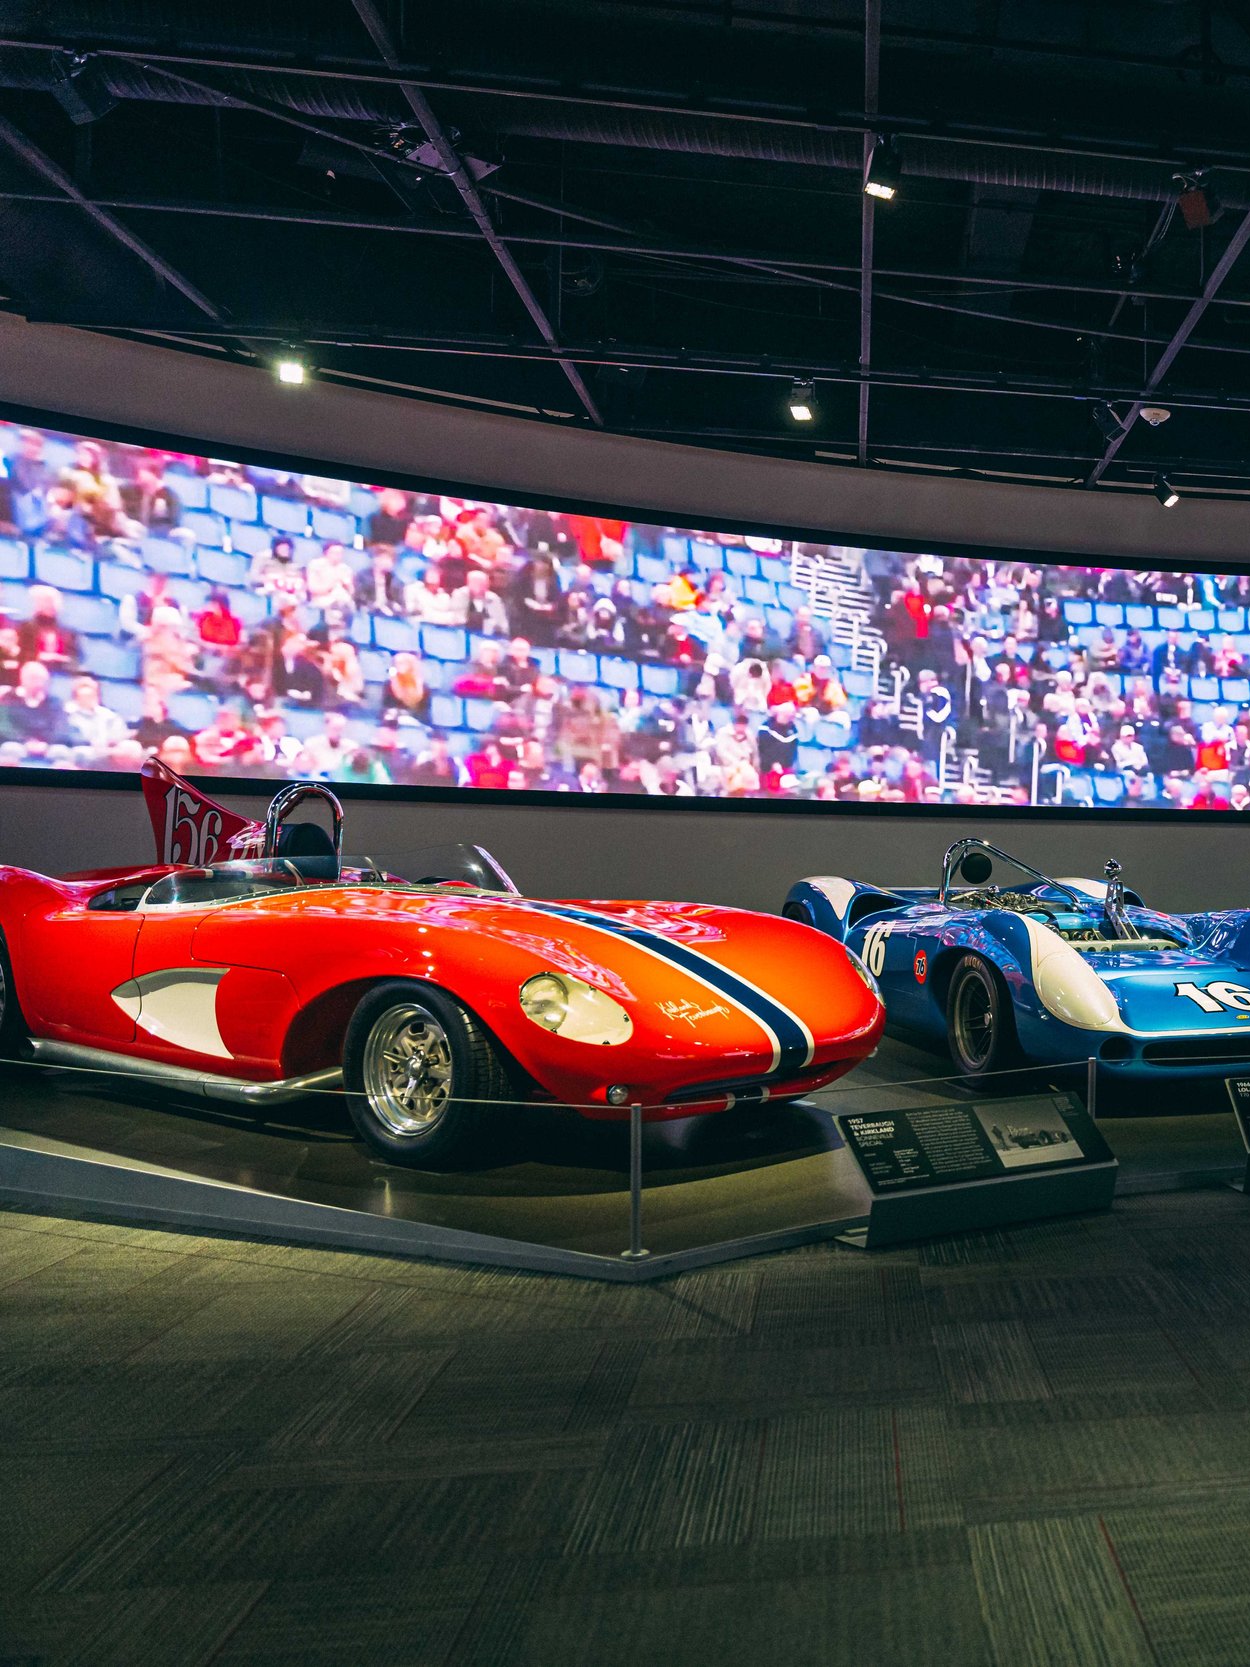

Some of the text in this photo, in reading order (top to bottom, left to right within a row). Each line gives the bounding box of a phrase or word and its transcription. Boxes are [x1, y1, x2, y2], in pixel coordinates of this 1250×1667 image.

[164, 784, 223, 868] 156
[861, 920, 897, 977] 16
[847, 1117, 863, 1125] 1957
[850, 1120, 895, 1131] TEVERBAUGH
[860, 1126, 895, 1136] KIRKLAND
